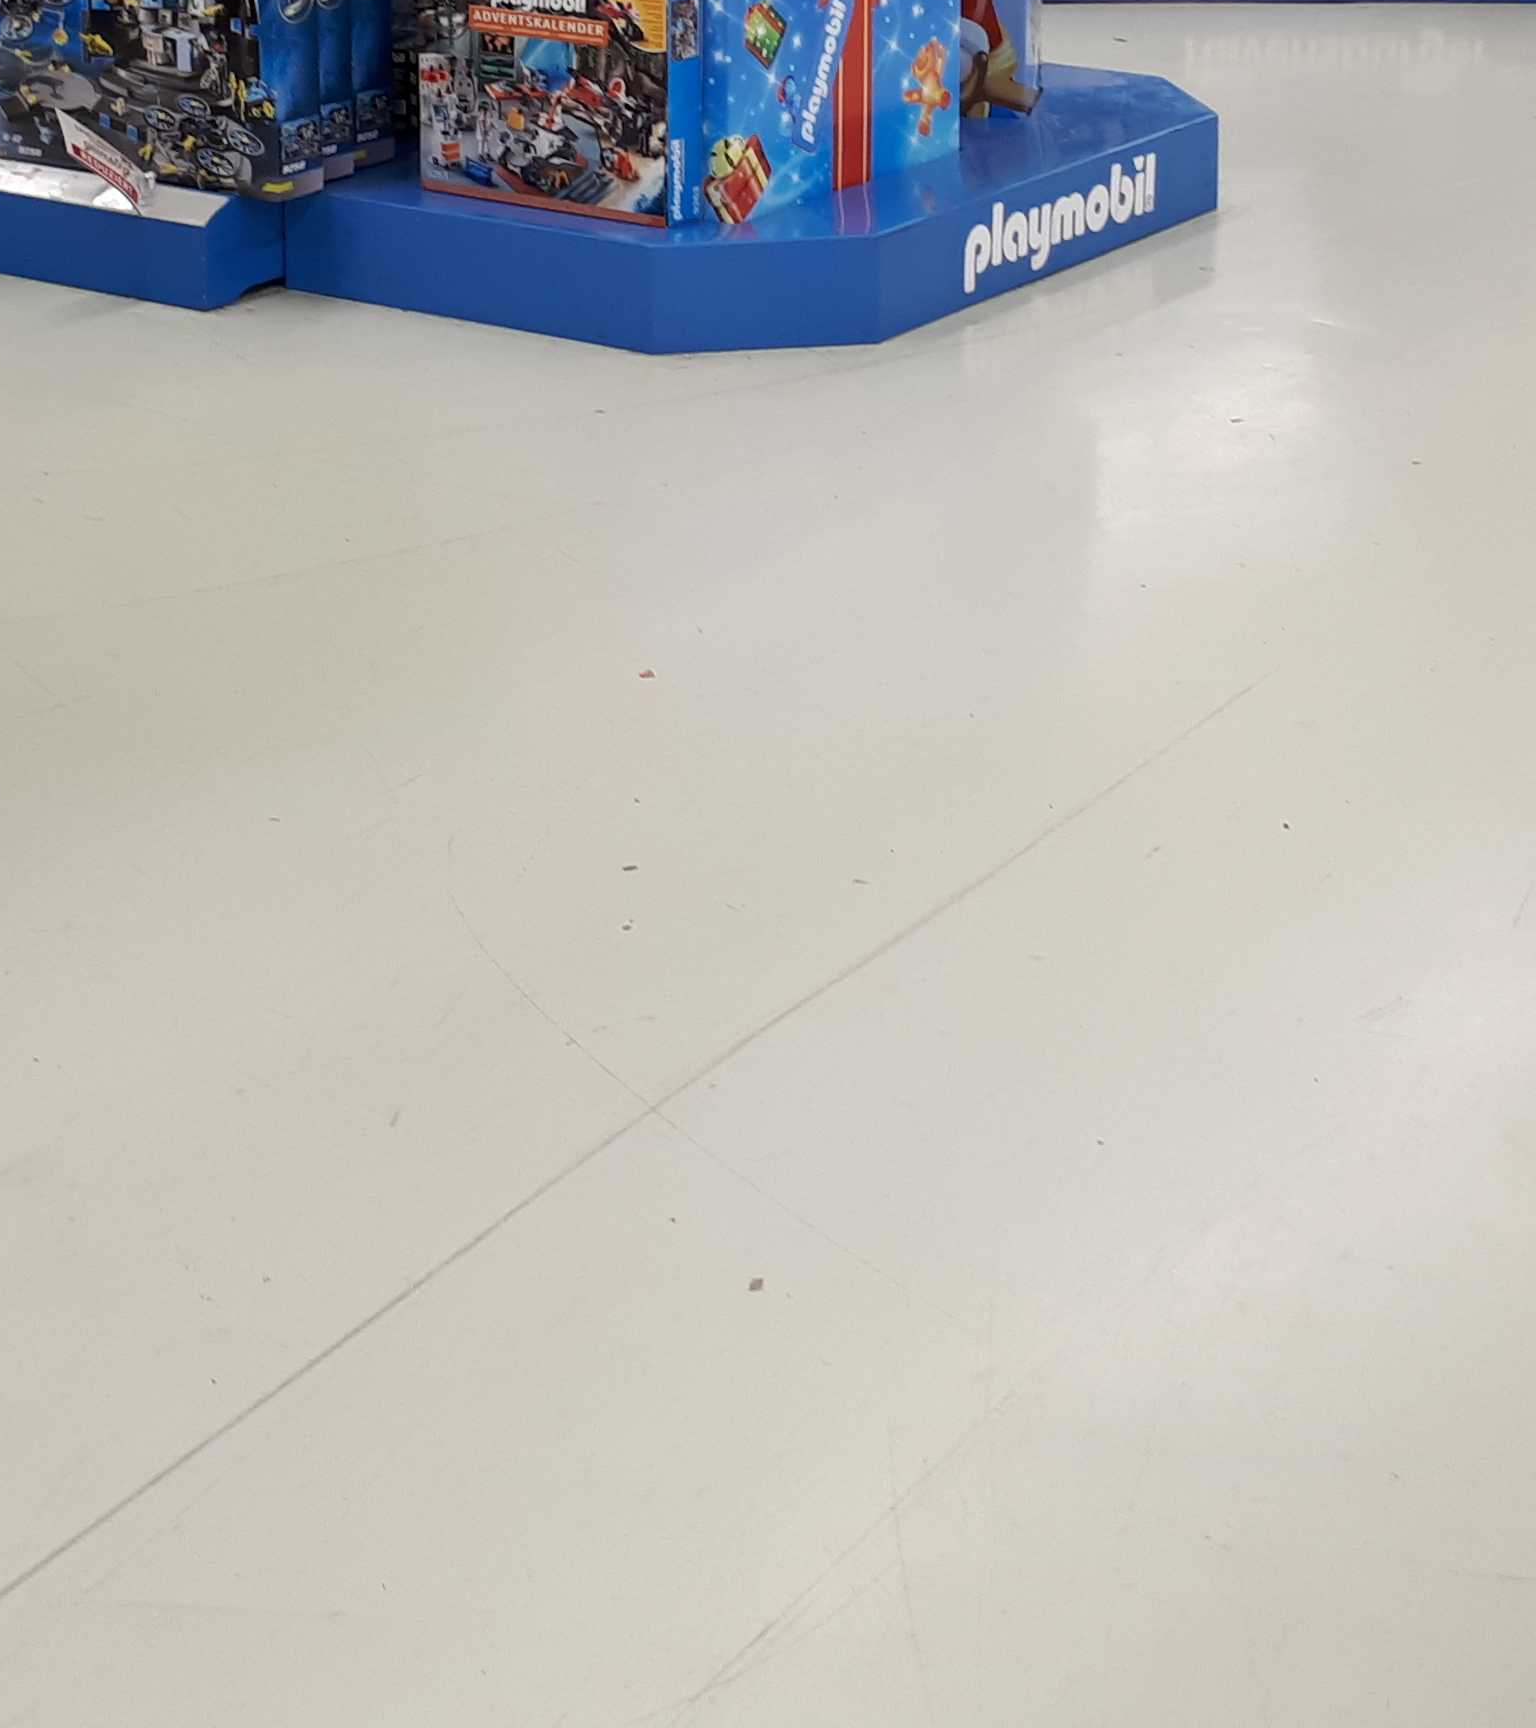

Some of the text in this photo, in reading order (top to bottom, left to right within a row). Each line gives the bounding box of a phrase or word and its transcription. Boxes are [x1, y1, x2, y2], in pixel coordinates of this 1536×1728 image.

[472, 8, 605, 38] ADVENTSKALENDER
[669, 138, 683, 221] playmobil
[964, 153, 1158, 294] playmobil
